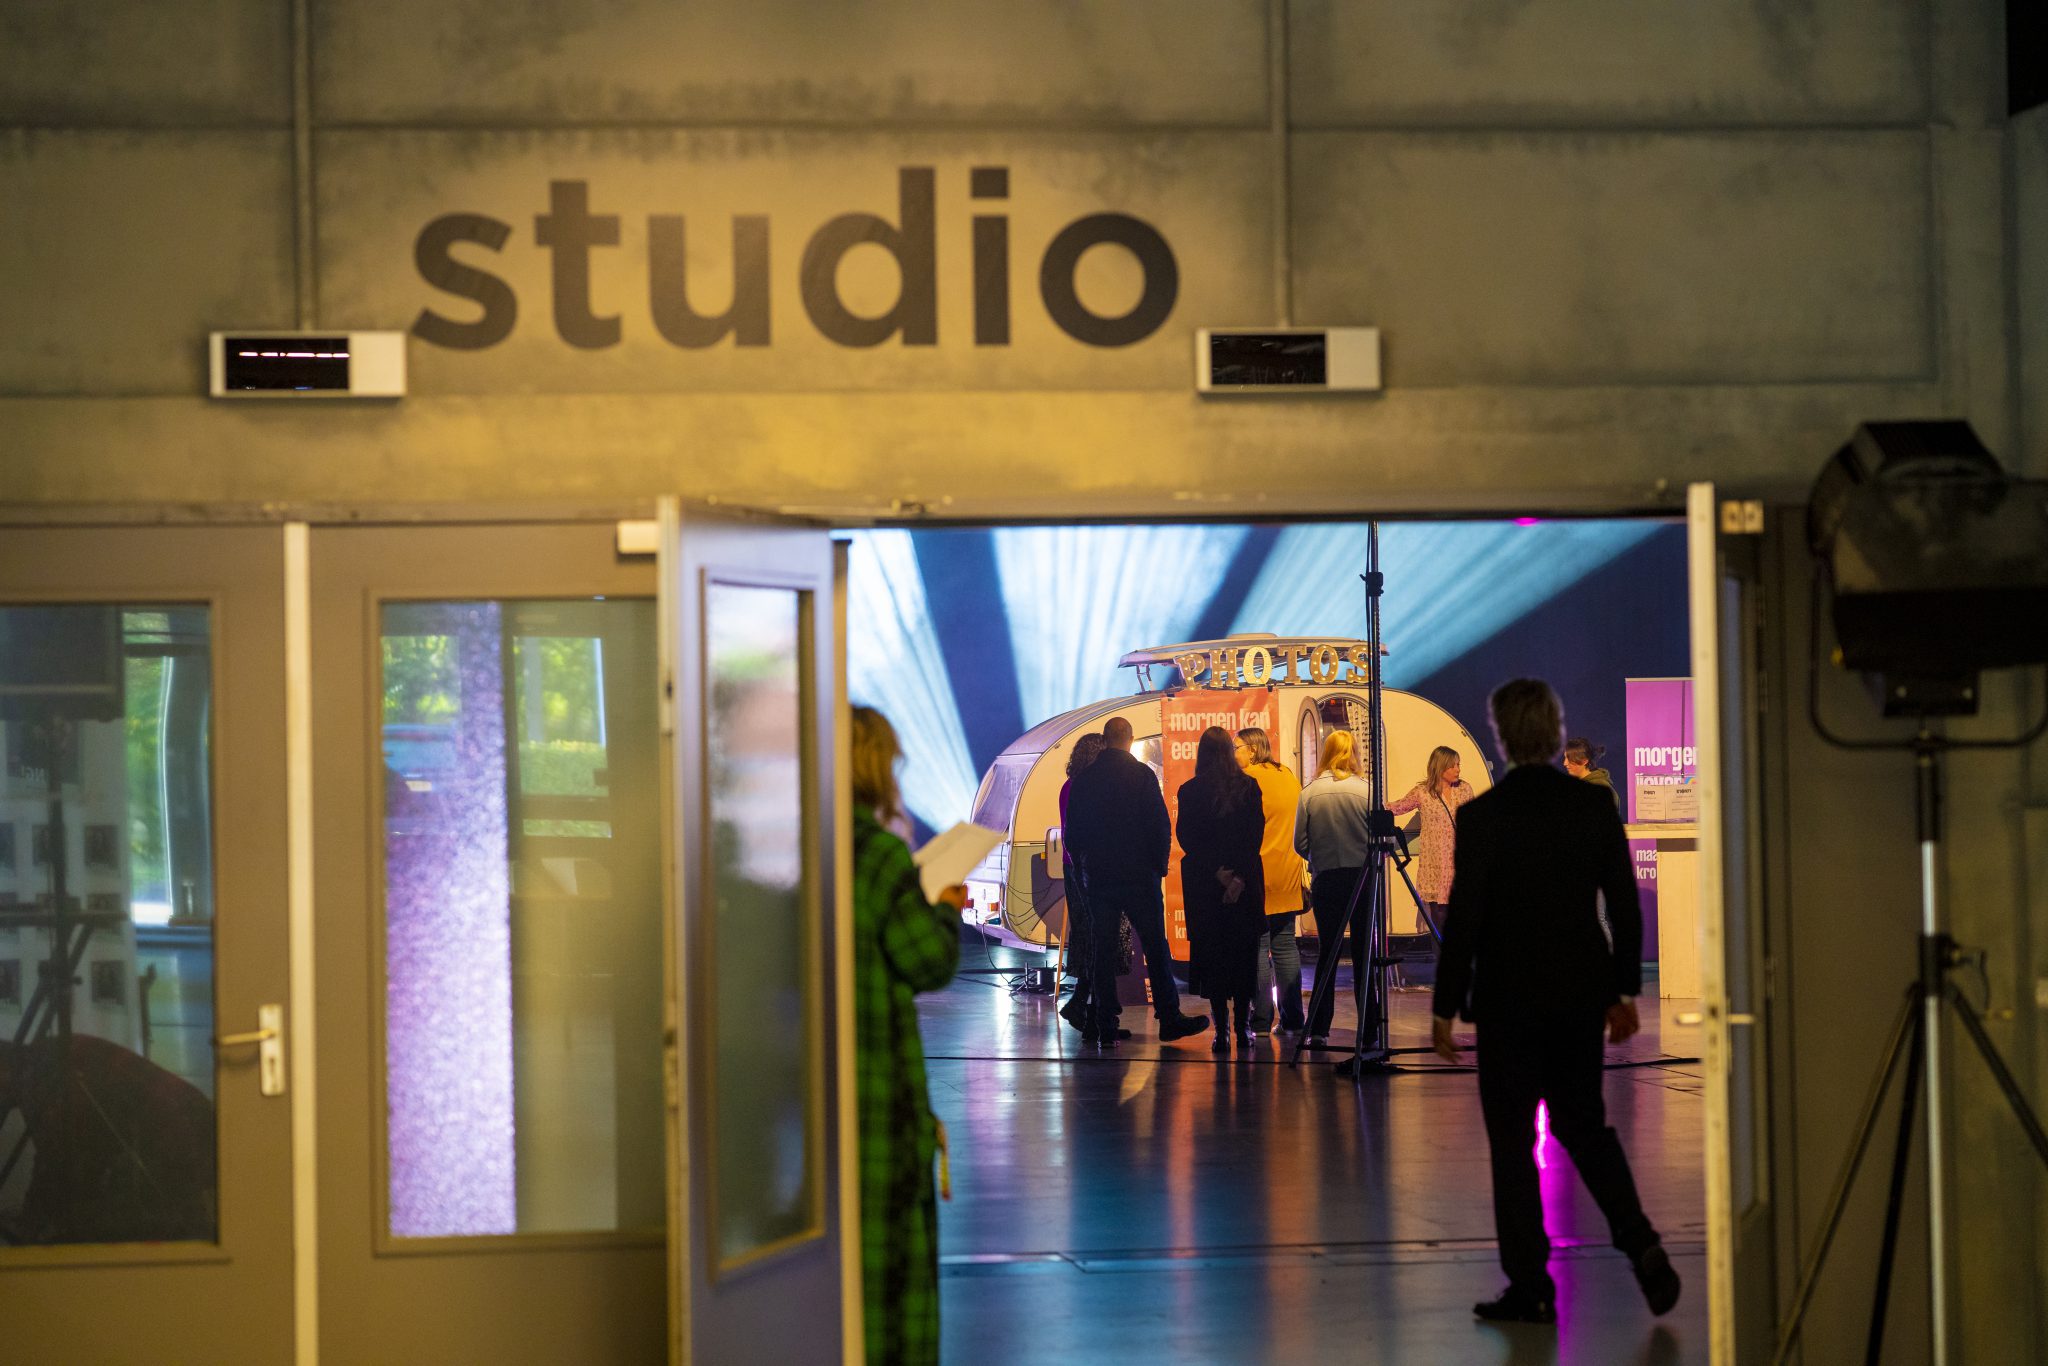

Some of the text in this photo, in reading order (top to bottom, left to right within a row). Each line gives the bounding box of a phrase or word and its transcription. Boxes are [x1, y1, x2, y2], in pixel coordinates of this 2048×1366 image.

[410, 166, 1180, 351] studio
[1173, 644, 1372, 691] PHOTOS
[1239, 708, 1271, 731] kan
